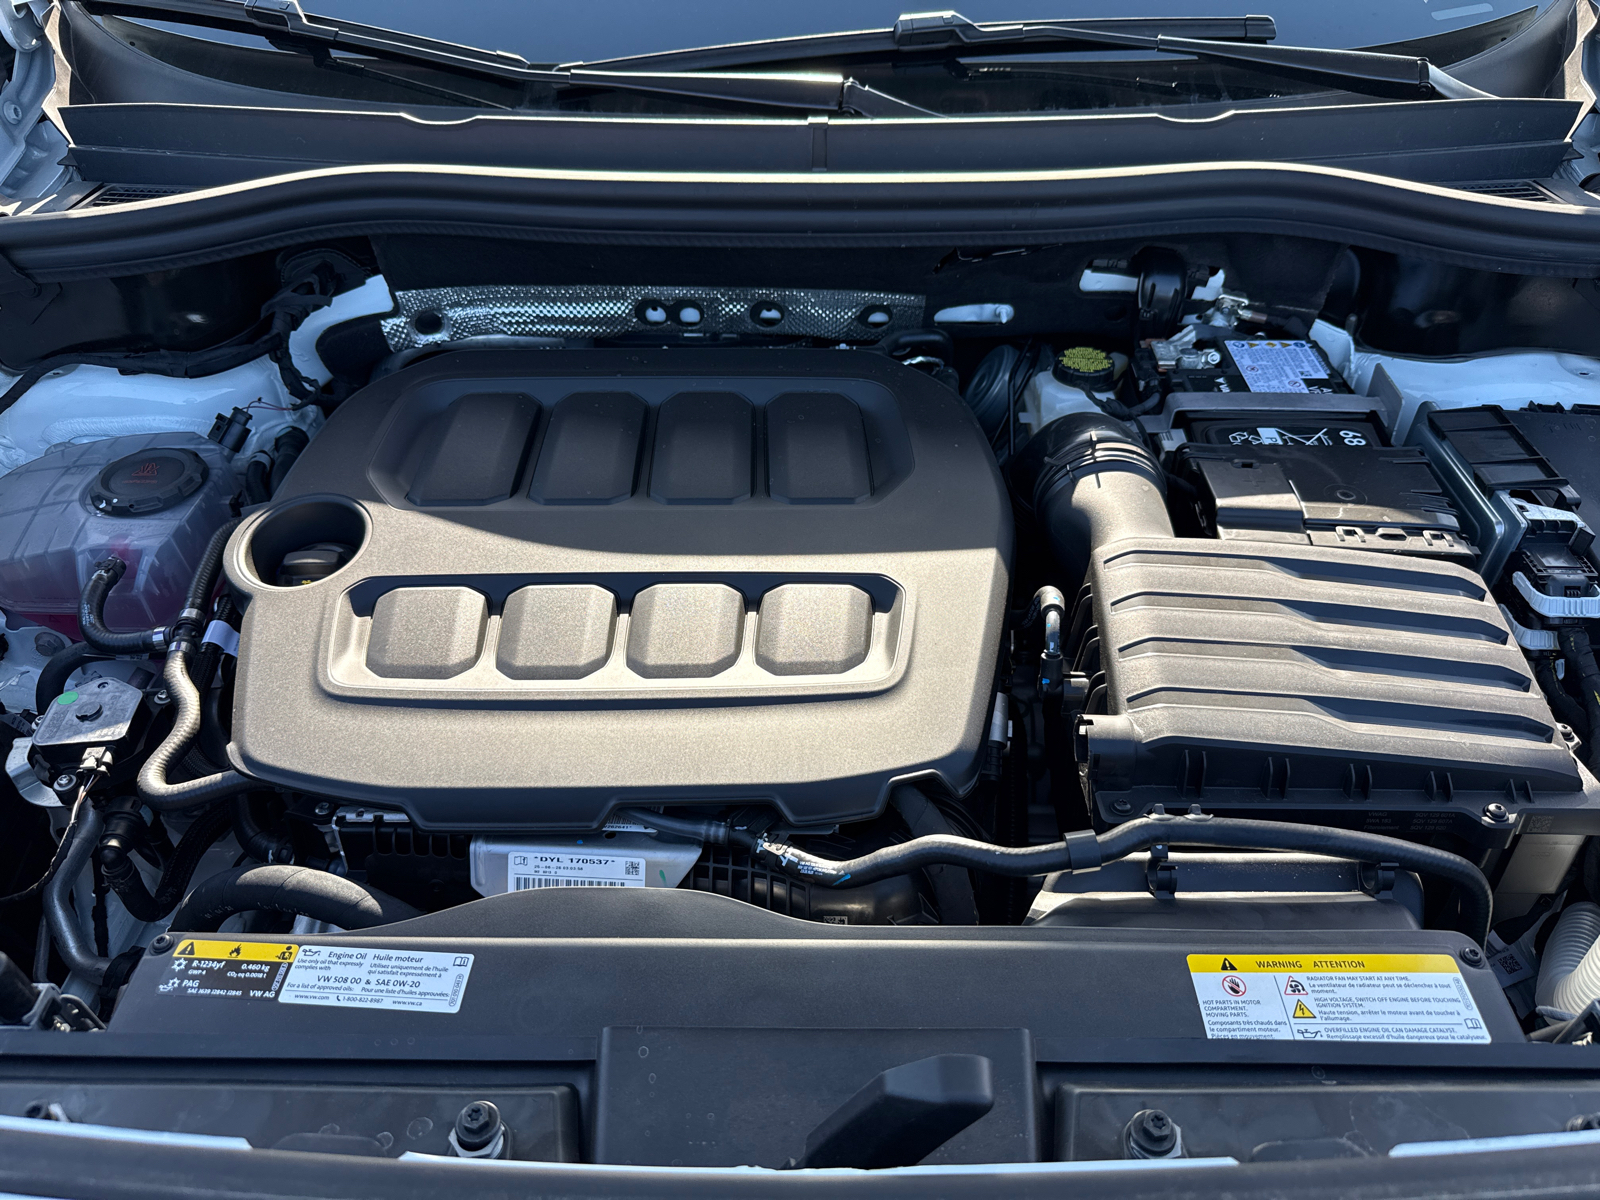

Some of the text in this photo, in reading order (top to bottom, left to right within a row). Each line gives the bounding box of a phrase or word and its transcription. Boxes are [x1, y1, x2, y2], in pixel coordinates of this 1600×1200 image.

[1339, 430, 1366, 446] 68
[328, 951, 354, 960] Engine
[191, 960, 226, 969] R-1234yf
[392, 980, 420, 988] 0W-20
